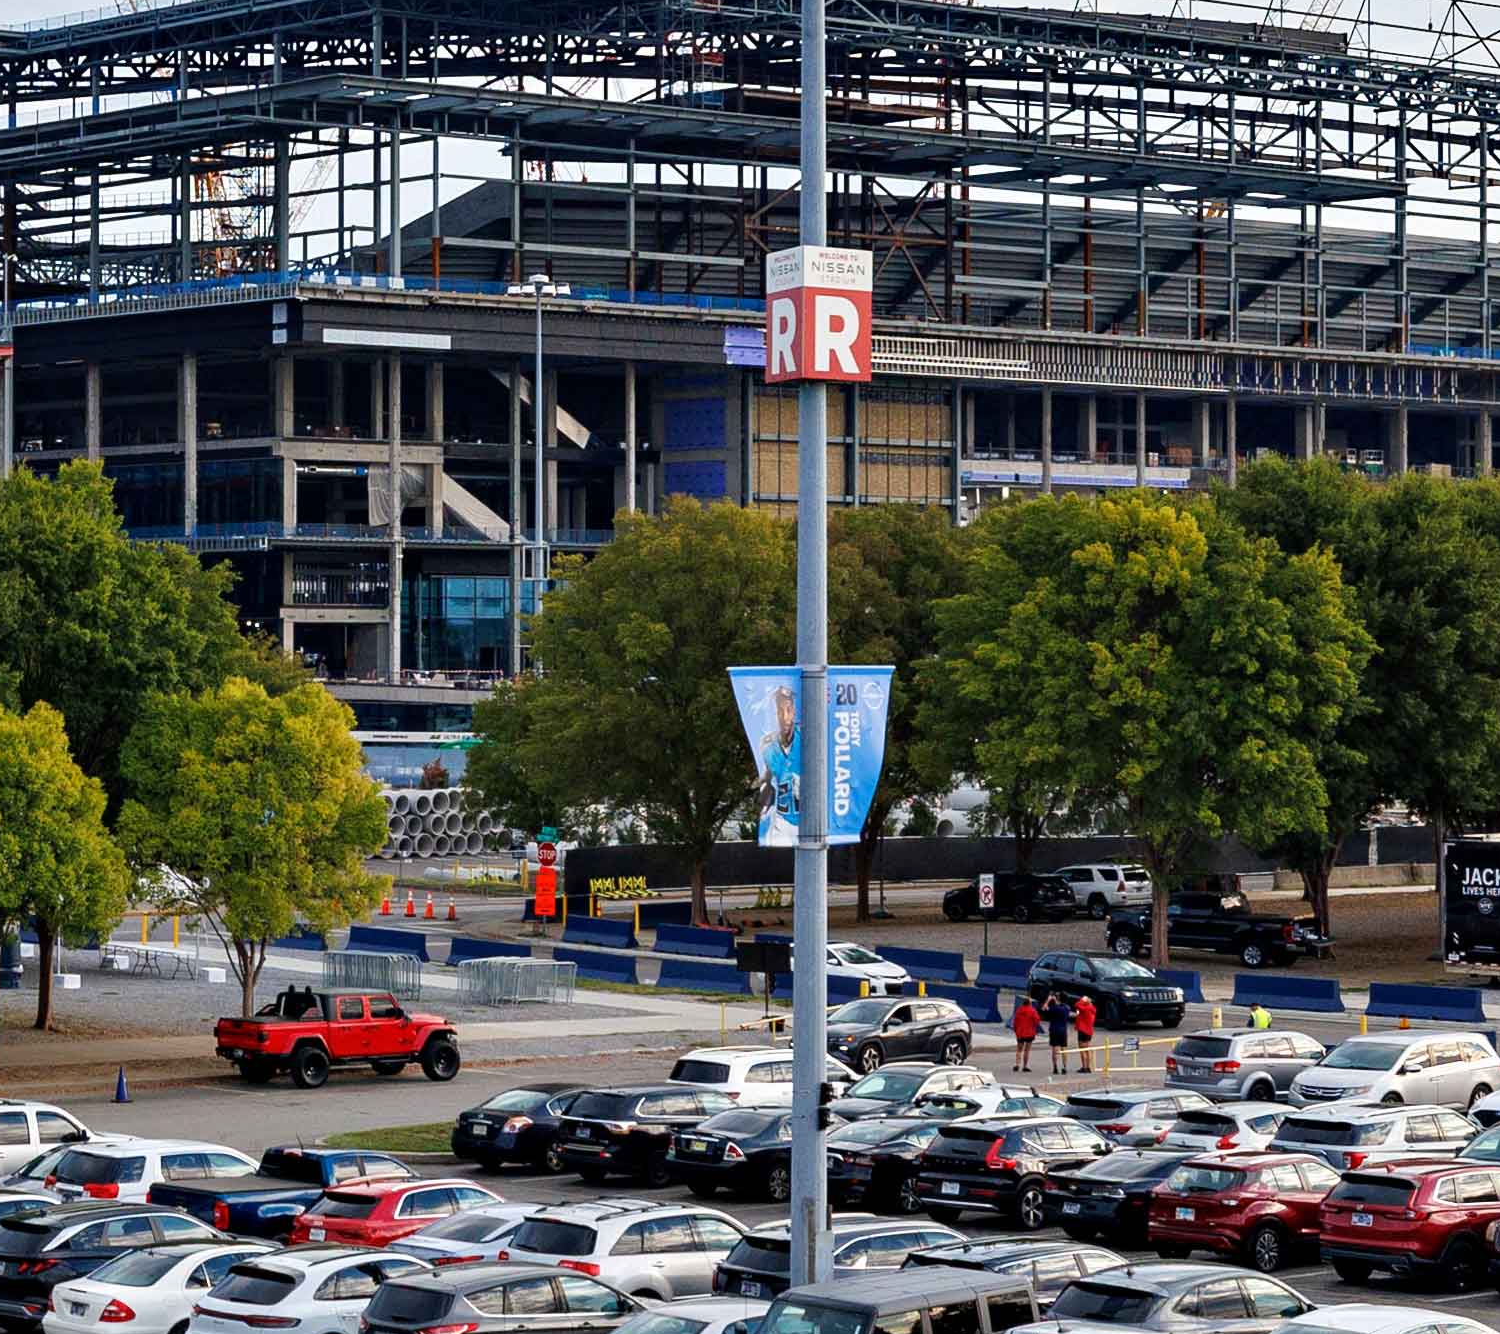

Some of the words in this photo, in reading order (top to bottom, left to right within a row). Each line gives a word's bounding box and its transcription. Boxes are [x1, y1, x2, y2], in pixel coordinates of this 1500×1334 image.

[811, 262, 866, 276] NISSAN
[771, 297, 797, 375] R
[814, 295, 861, 375] R
[836, 684, 857, 705] 20
[851, 712, 862, 748] TONY
[833, 712, 851, 817] POLLARD
[538, 850, 556, 860] STOP
[1462, 886, 1485, 896] LIVES
